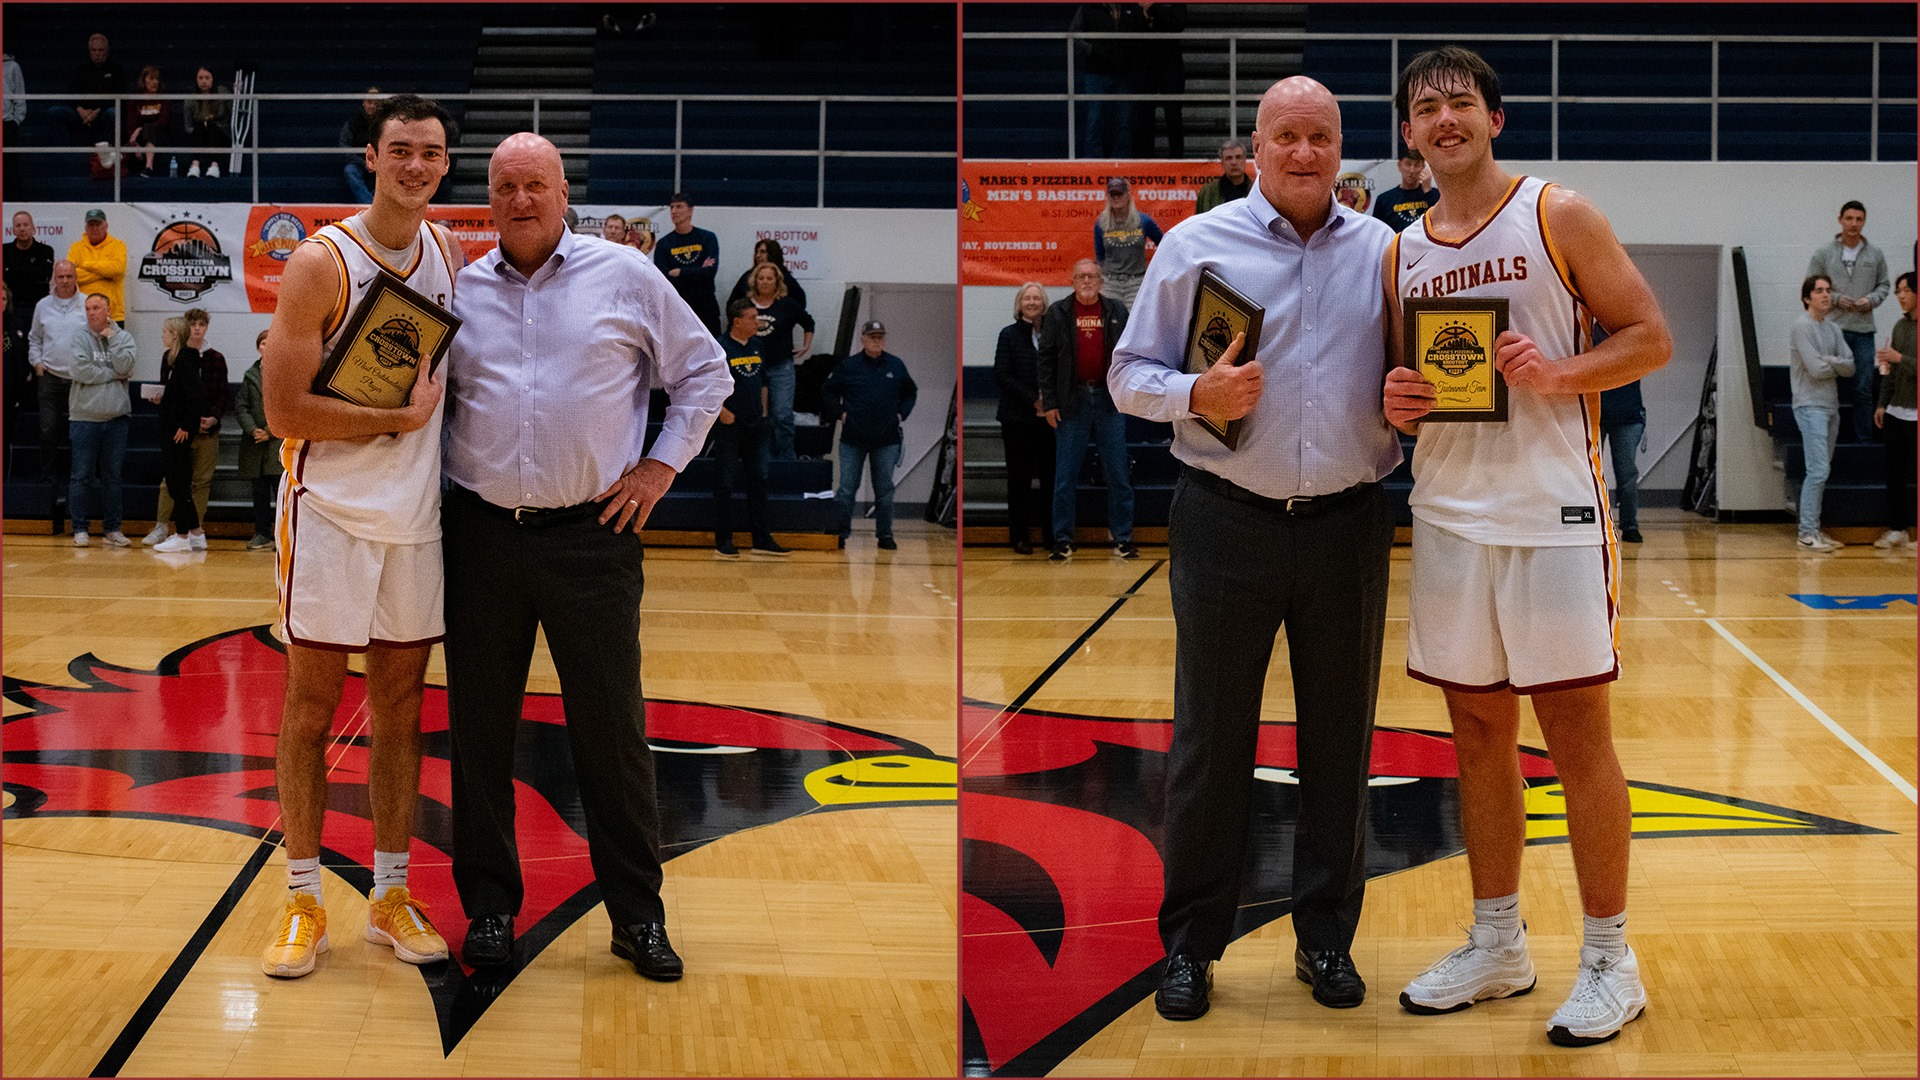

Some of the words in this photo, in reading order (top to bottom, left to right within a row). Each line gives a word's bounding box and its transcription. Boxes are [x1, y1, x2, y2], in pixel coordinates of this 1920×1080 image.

[980, 176, 1028, 185] MARK'S
[1033, 176, 1093, 185] PIZZERIA
[1097, 176, 1176, 185] CSTOWN
[1181, 176, 1220, 185] SHOOT
[1336, 179, 1376, 190] ISHER
[987, 190, 1032, 201] MEN'S
[1037, 190, 1105, 201] BASKETB
[1138, 189, 1198, 201] TOURNA
[453, 231, 501, 241] TOURNA
[774, 231, 818, 241] BOTTOM
[781, 246, 799, 256] OW
[983, 242, 1043, 250] NOVEMBER
[142, 264, 230, 277] CROSSTOWN
[166, 275, 206, 283] SHOOTOUT
[369, 333, 418, 366] CROSSTOWN
[1427, 353, 1485, 361] CROSSTOWN
[1583, 511, 1593, 519] XL
